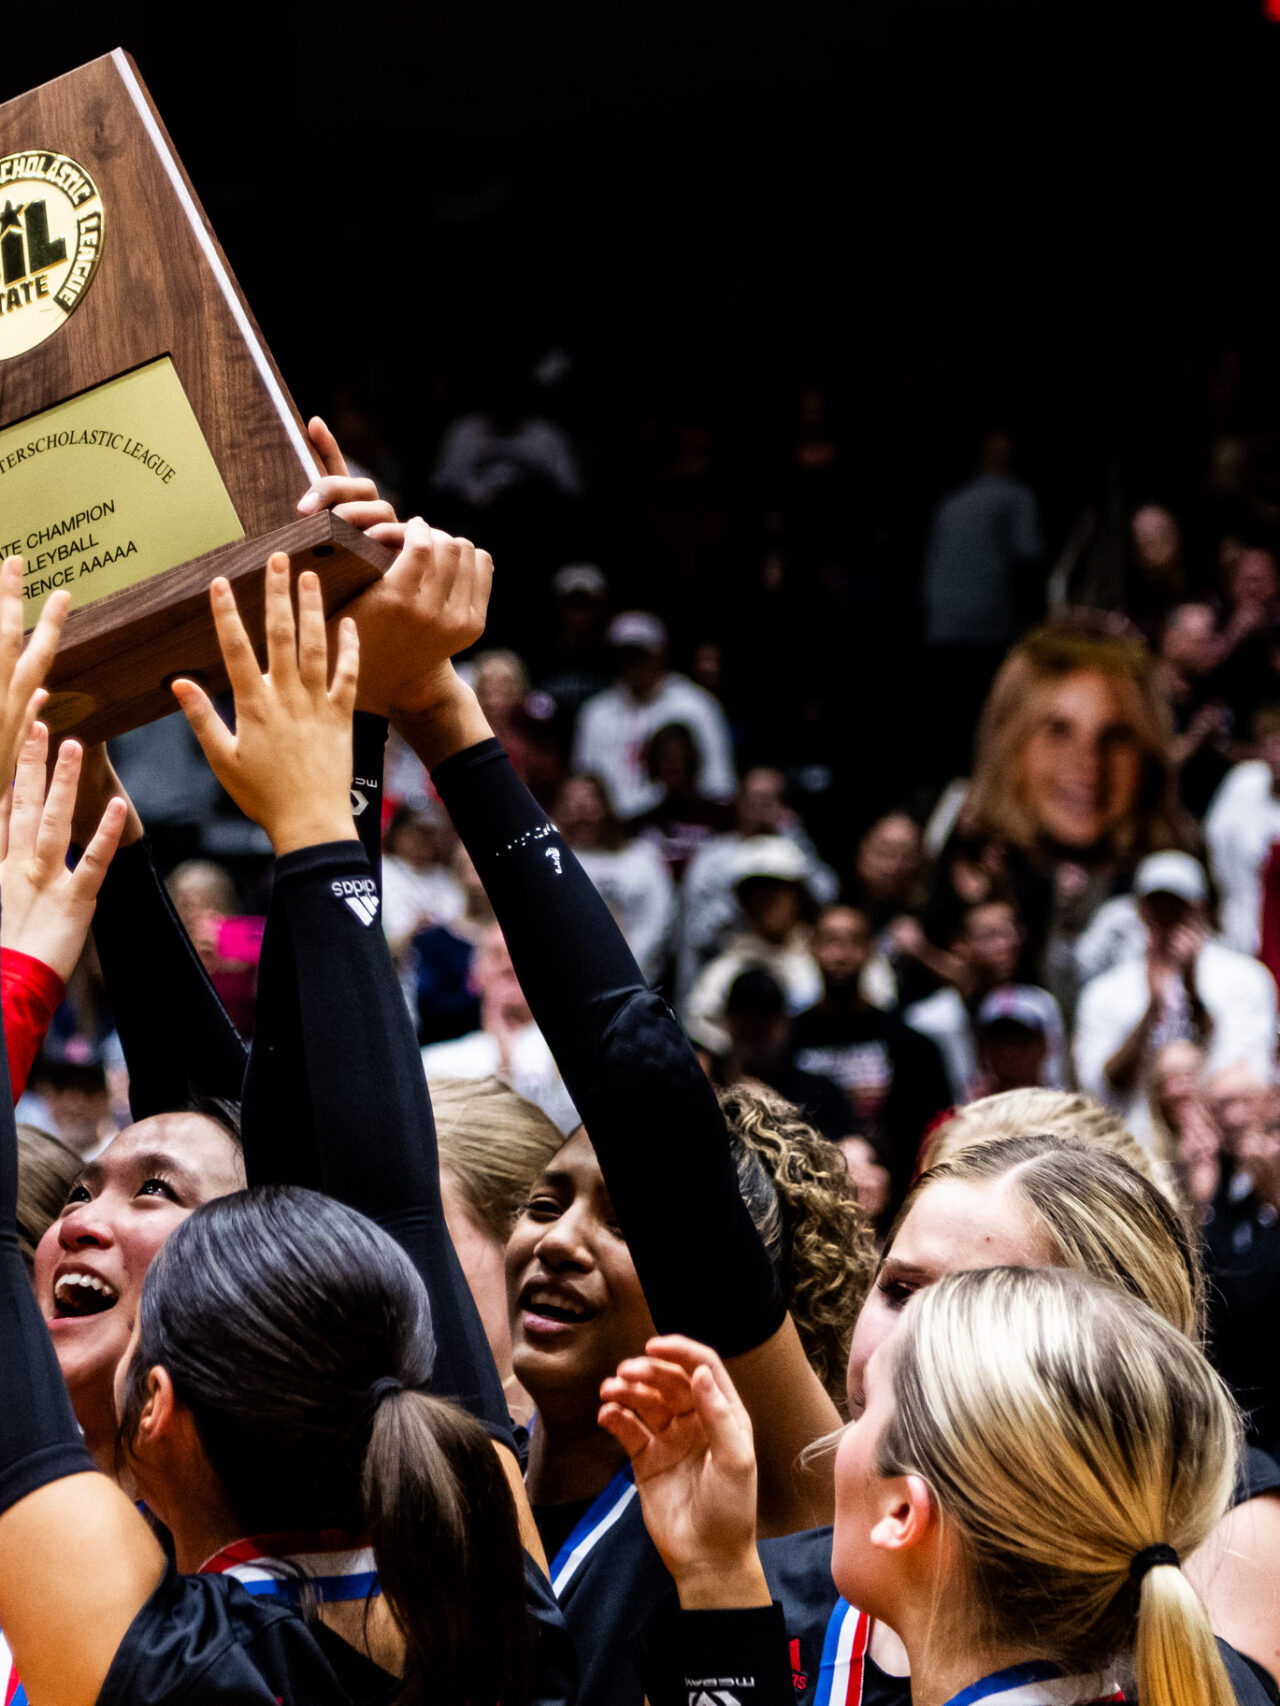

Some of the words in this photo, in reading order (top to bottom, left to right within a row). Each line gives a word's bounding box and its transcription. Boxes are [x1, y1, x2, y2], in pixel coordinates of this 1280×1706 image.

[59, 214, 101, 307] LEAGUE
[122, 438, 176, 485] LEAGUE
[26, 499, 115, 550] CHAMPION
[79, 540, 138, 577] AAAAA
[331, 878, 378, 897] didas
